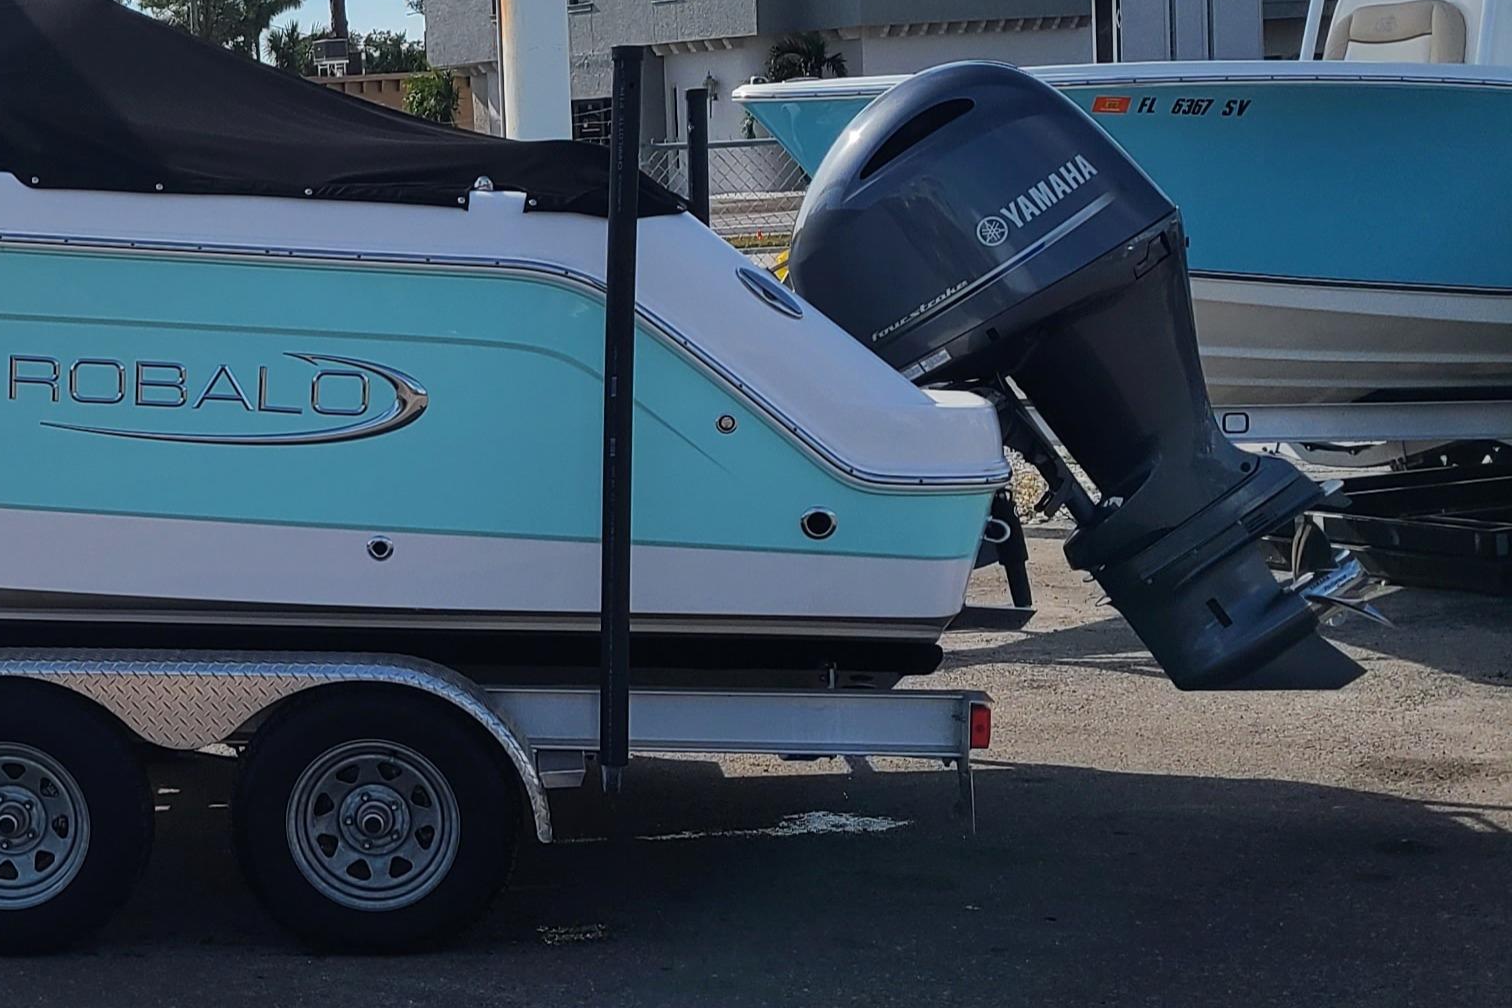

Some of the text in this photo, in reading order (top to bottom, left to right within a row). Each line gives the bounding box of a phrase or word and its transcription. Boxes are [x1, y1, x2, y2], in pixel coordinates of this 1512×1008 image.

[1137, 96, 1157, 114] FL
[1170, 98, 1215, 116] 6367
[1221, 99, 1252, 117] SV
[999, 153, 1099, 229] YAMAHA
[8, 353, 370, 417] ROBALO
